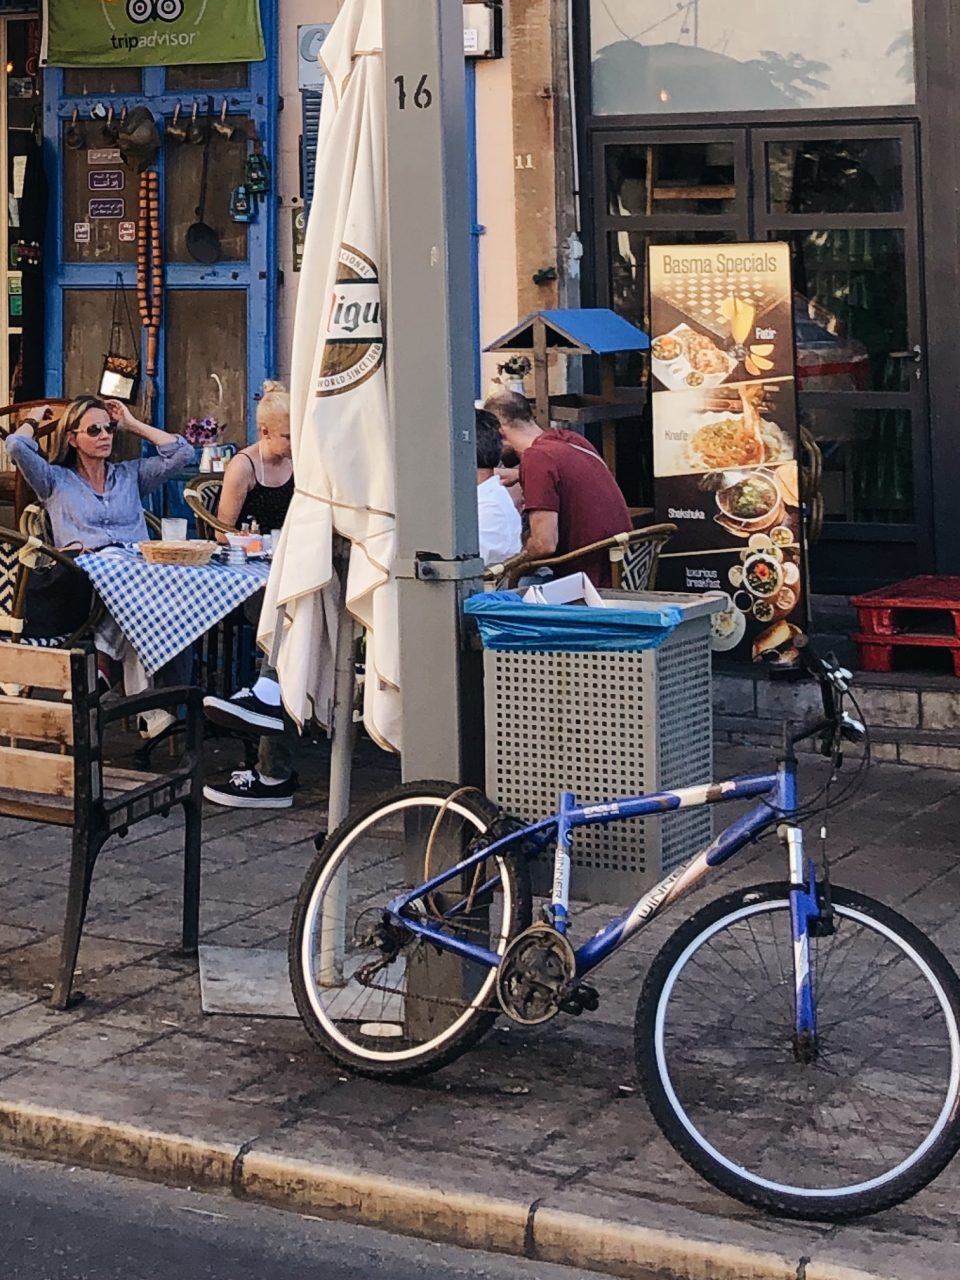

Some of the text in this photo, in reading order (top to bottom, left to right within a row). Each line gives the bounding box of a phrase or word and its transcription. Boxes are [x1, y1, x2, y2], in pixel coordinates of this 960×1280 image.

[111, 31, 196, 52] tripadvisor
[394, 74, 432, 110] 16
[515, 154, 534, 169] 11
[339, 251, 372, 276] CIONAL
[663, 253, 777, 278] Basma Specials
[346, 361, 369, 380] SINCE
[366, 344, 381, 363] 1890
[555, 848, 566, 899] WINNER
